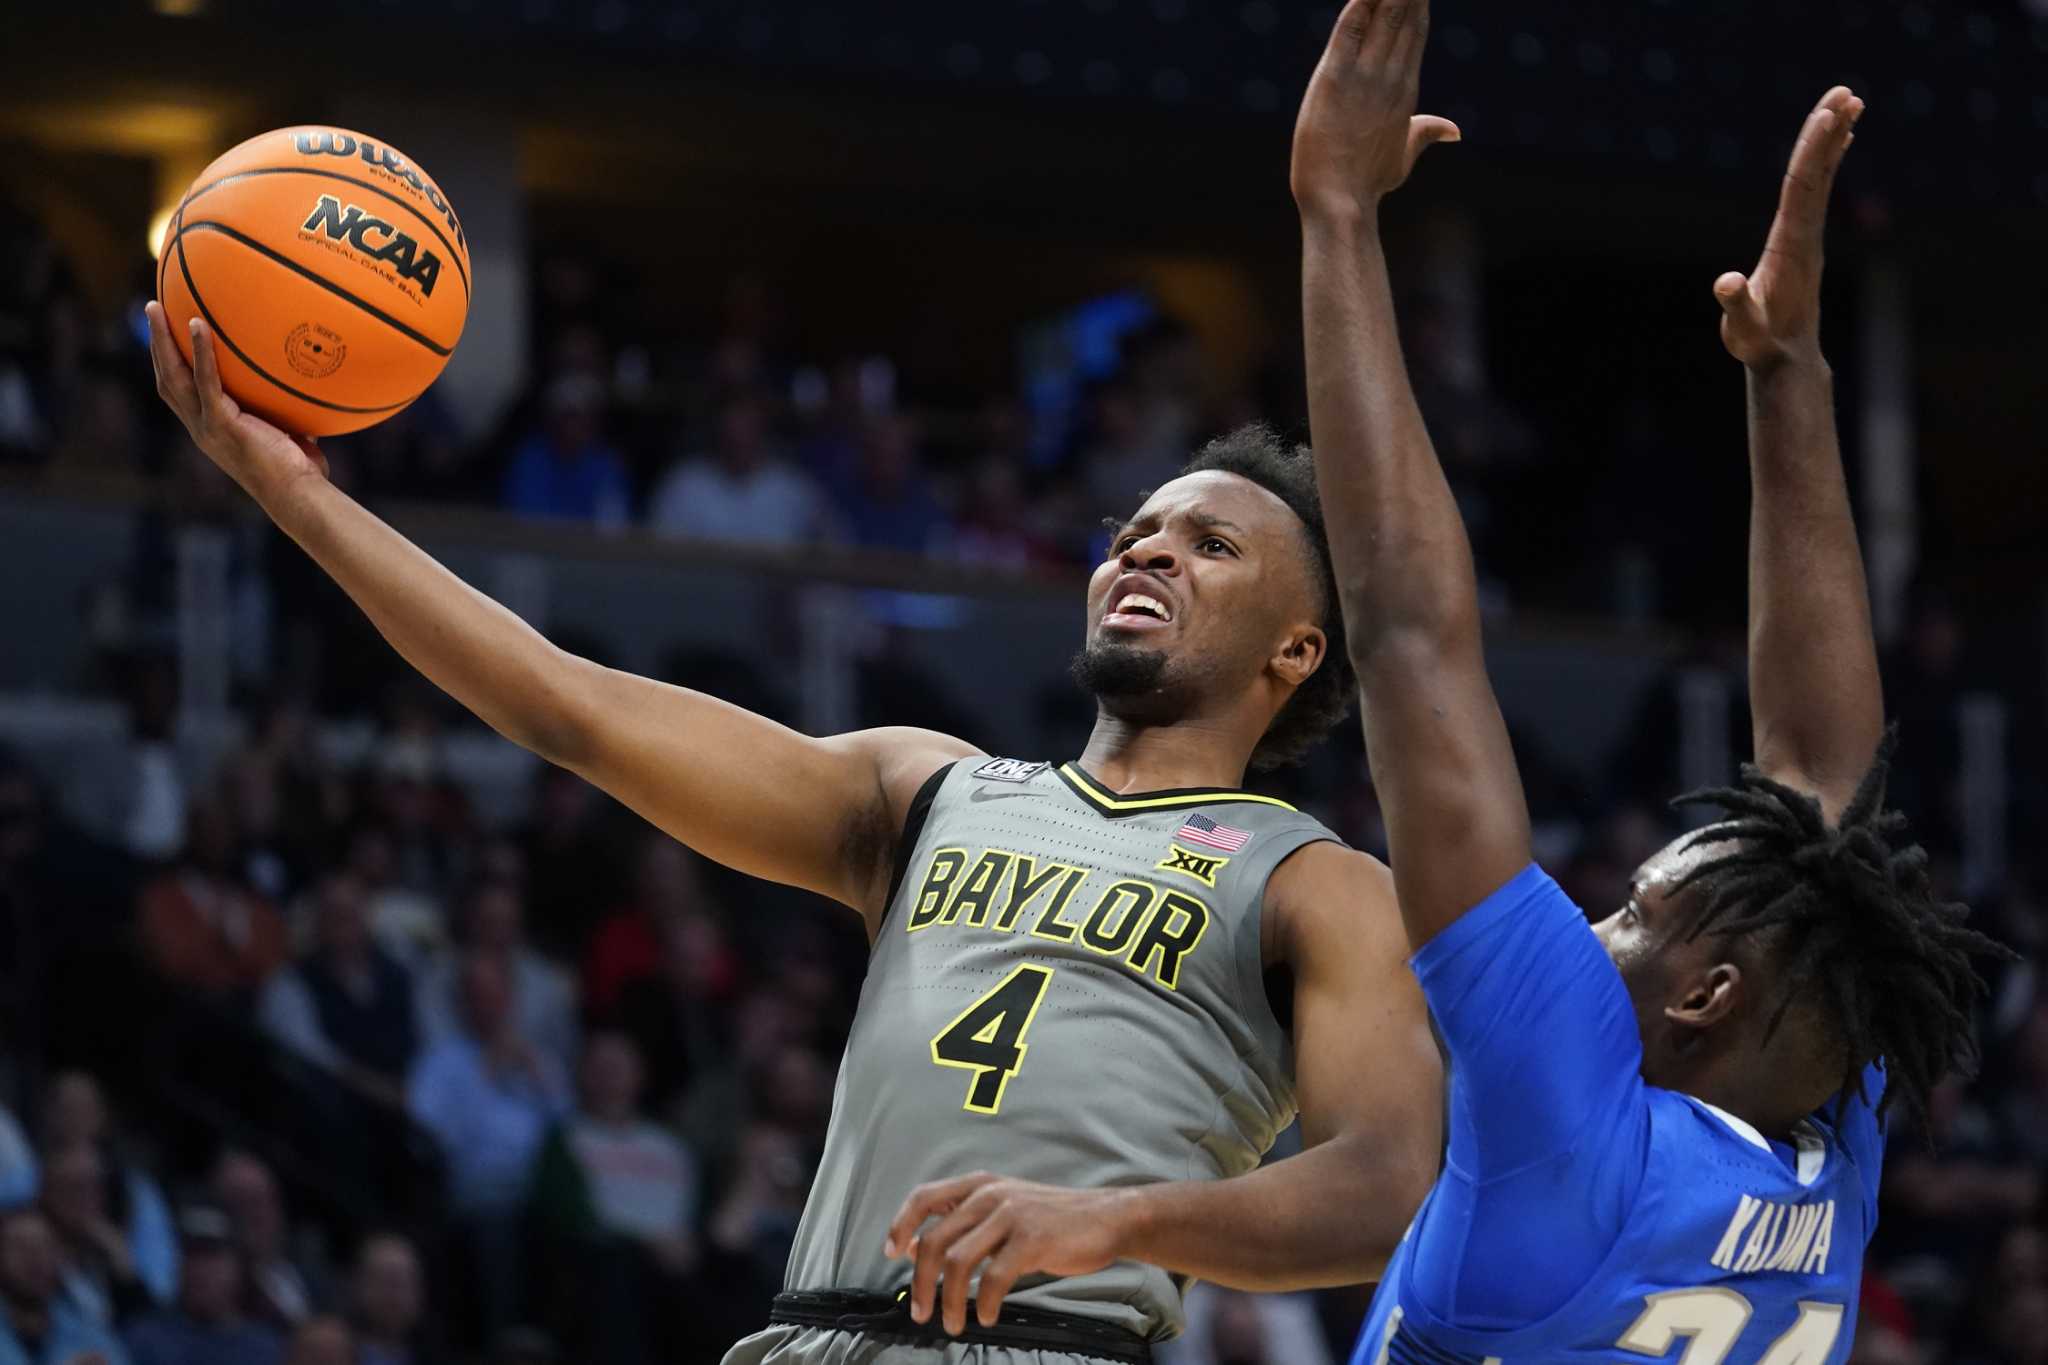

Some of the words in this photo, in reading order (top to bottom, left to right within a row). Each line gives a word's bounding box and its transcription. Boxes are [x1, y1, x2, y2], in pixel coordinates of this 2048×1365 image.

[301, 194, 441, 299] NCAA
[360, 258, 396, 284] GAME
[397, 281, 423, 307] BALL
[1162, 847, 1222, 882] XII
[907, 847, 1210, 991] BAYLOR
[929, 962, 1055, 1115] 4
